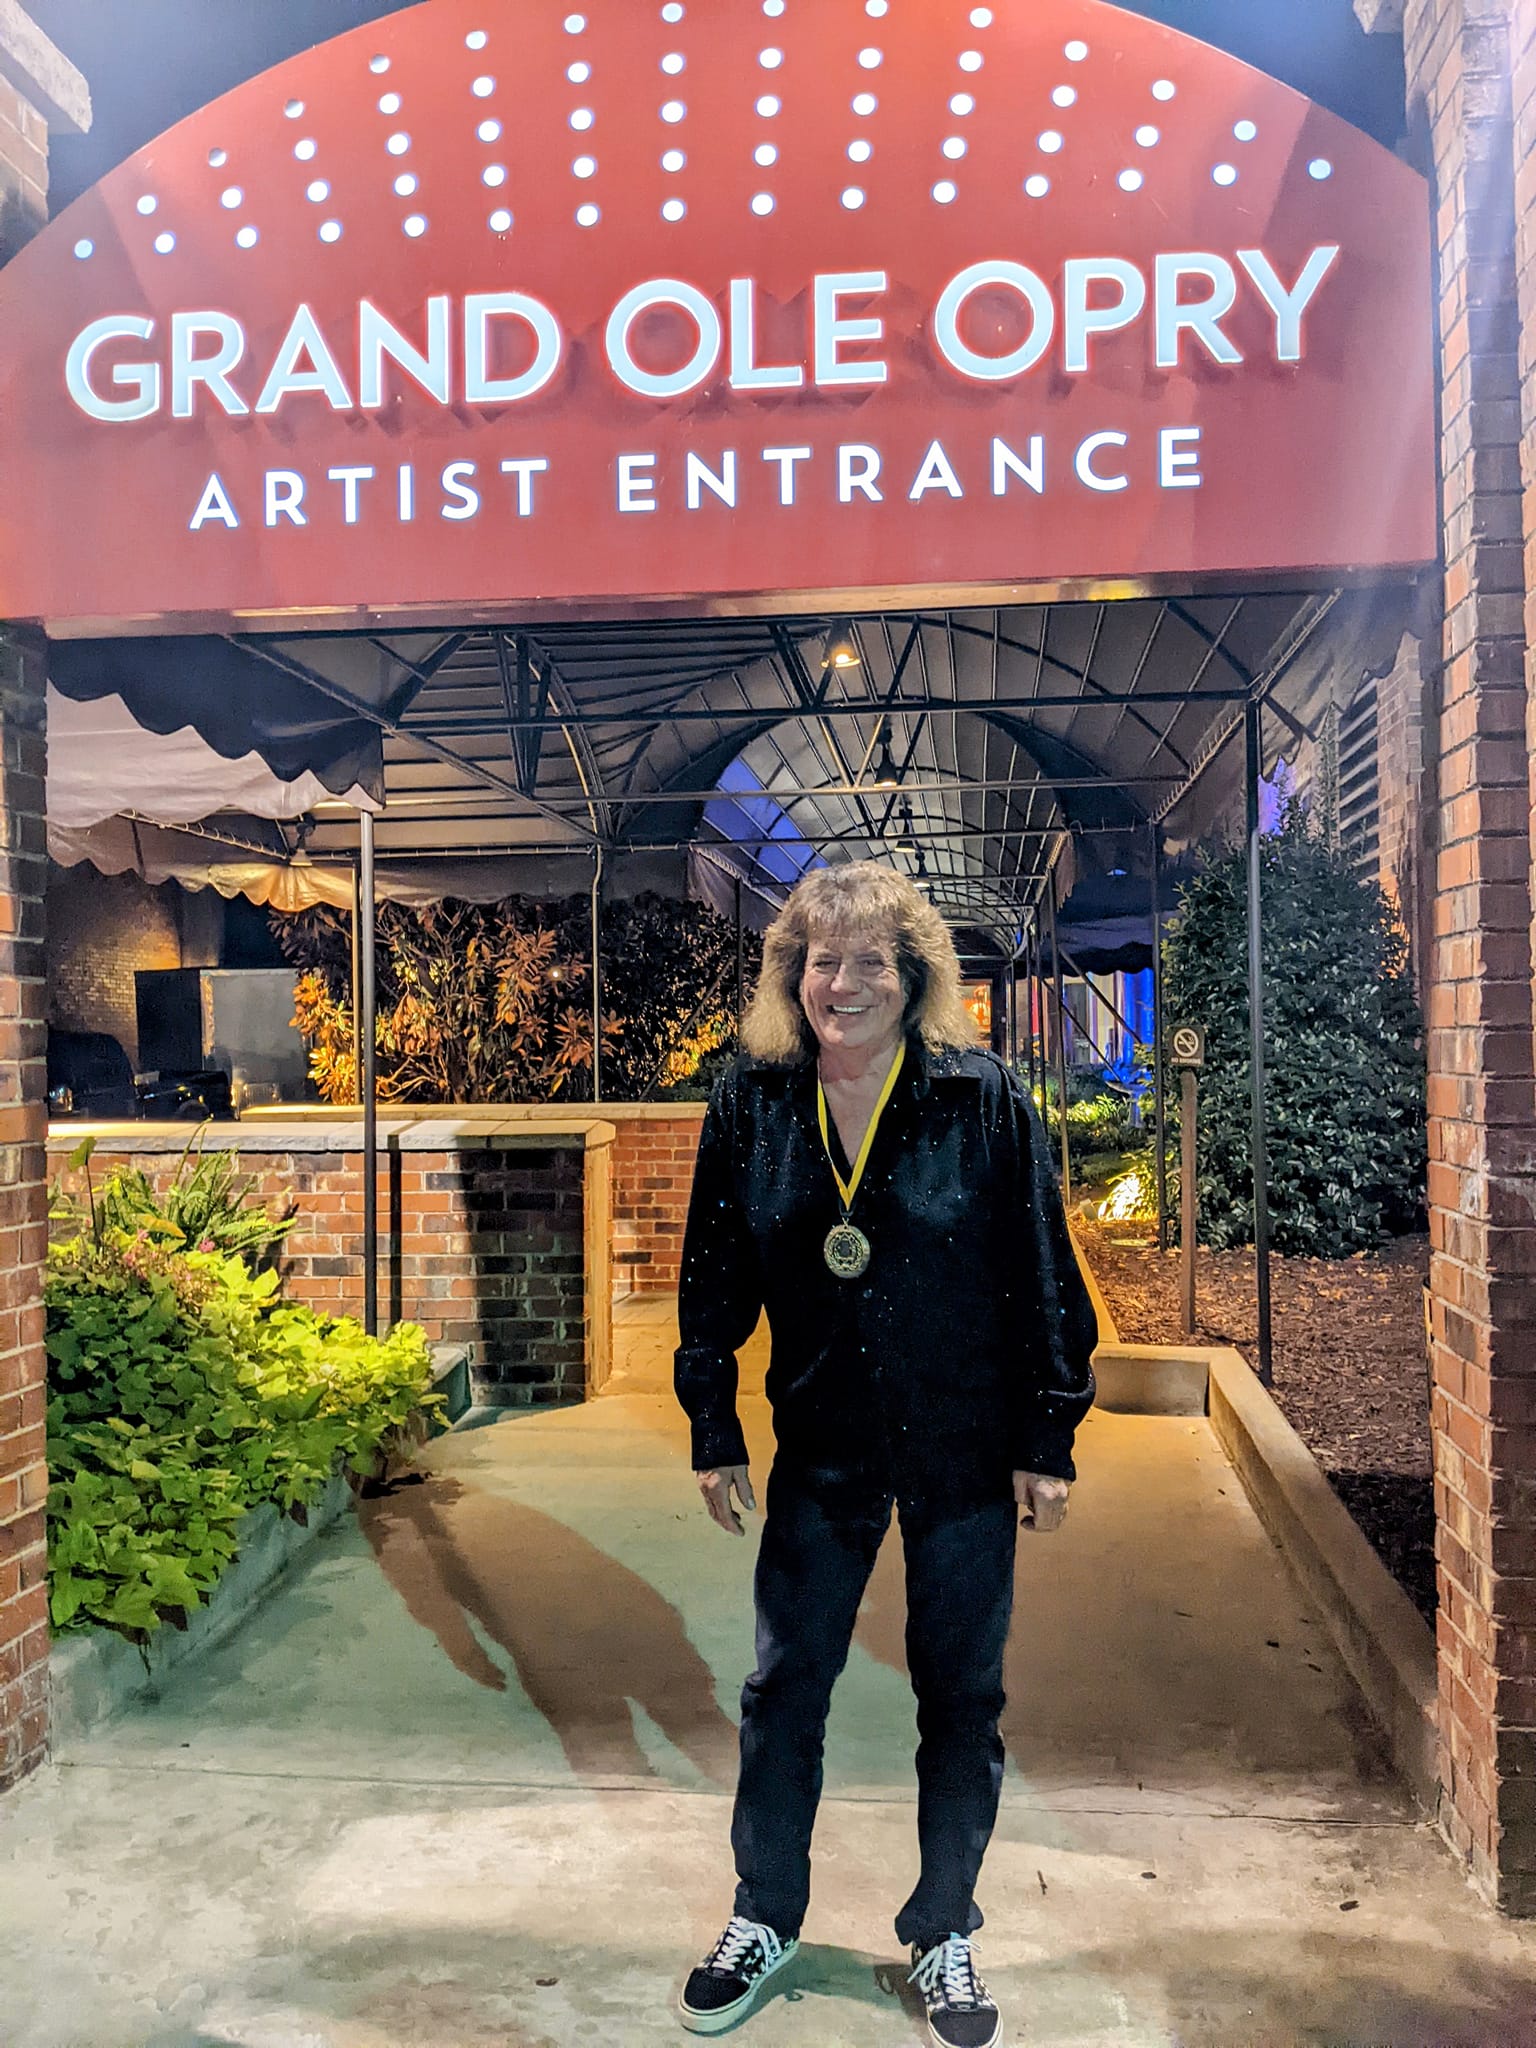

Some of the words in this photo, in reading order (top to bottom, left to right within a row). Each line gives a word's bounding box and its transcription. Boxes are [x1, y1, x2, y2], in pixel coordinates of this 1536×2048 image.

[65, 290, 562, 423] GRAND
[605, 270, 888, 398] OLE
[934, 244, 1340, 381] OPRY
[189, 458, 548, 530] ARTIST
[617, 427, 1202, 513] ENTRANCE
